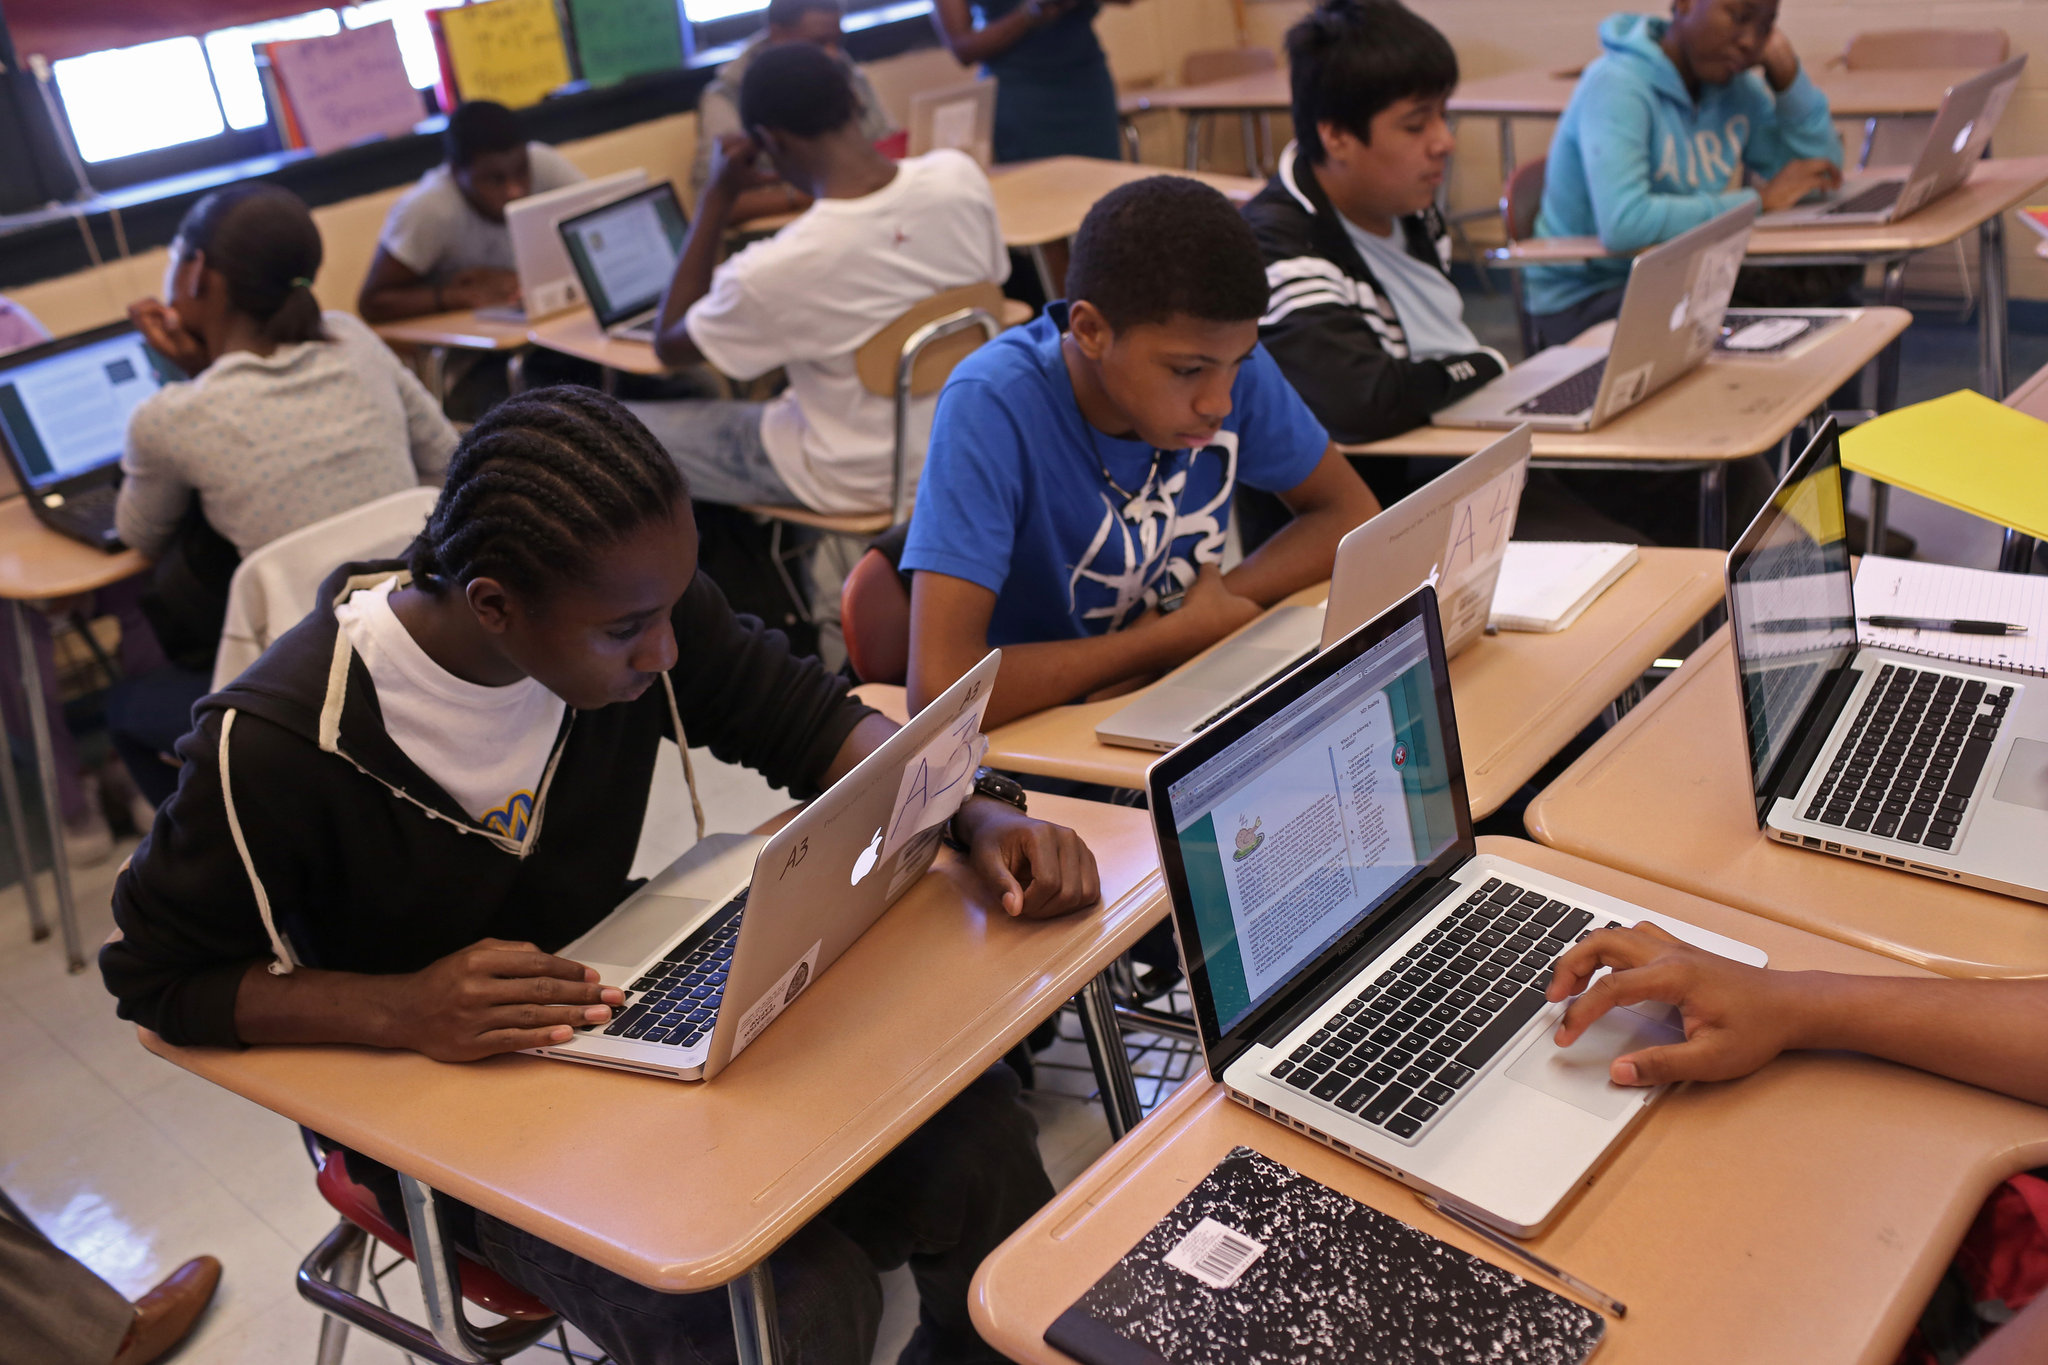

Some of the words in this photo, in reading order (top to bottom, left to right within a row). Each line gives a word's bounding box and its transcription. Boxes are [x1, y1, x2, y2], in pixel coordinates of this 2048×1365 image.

[960, 680, 981, 711] A3
[890, 713, 977, 841] A3
[780, 836, 809, 881] A3
